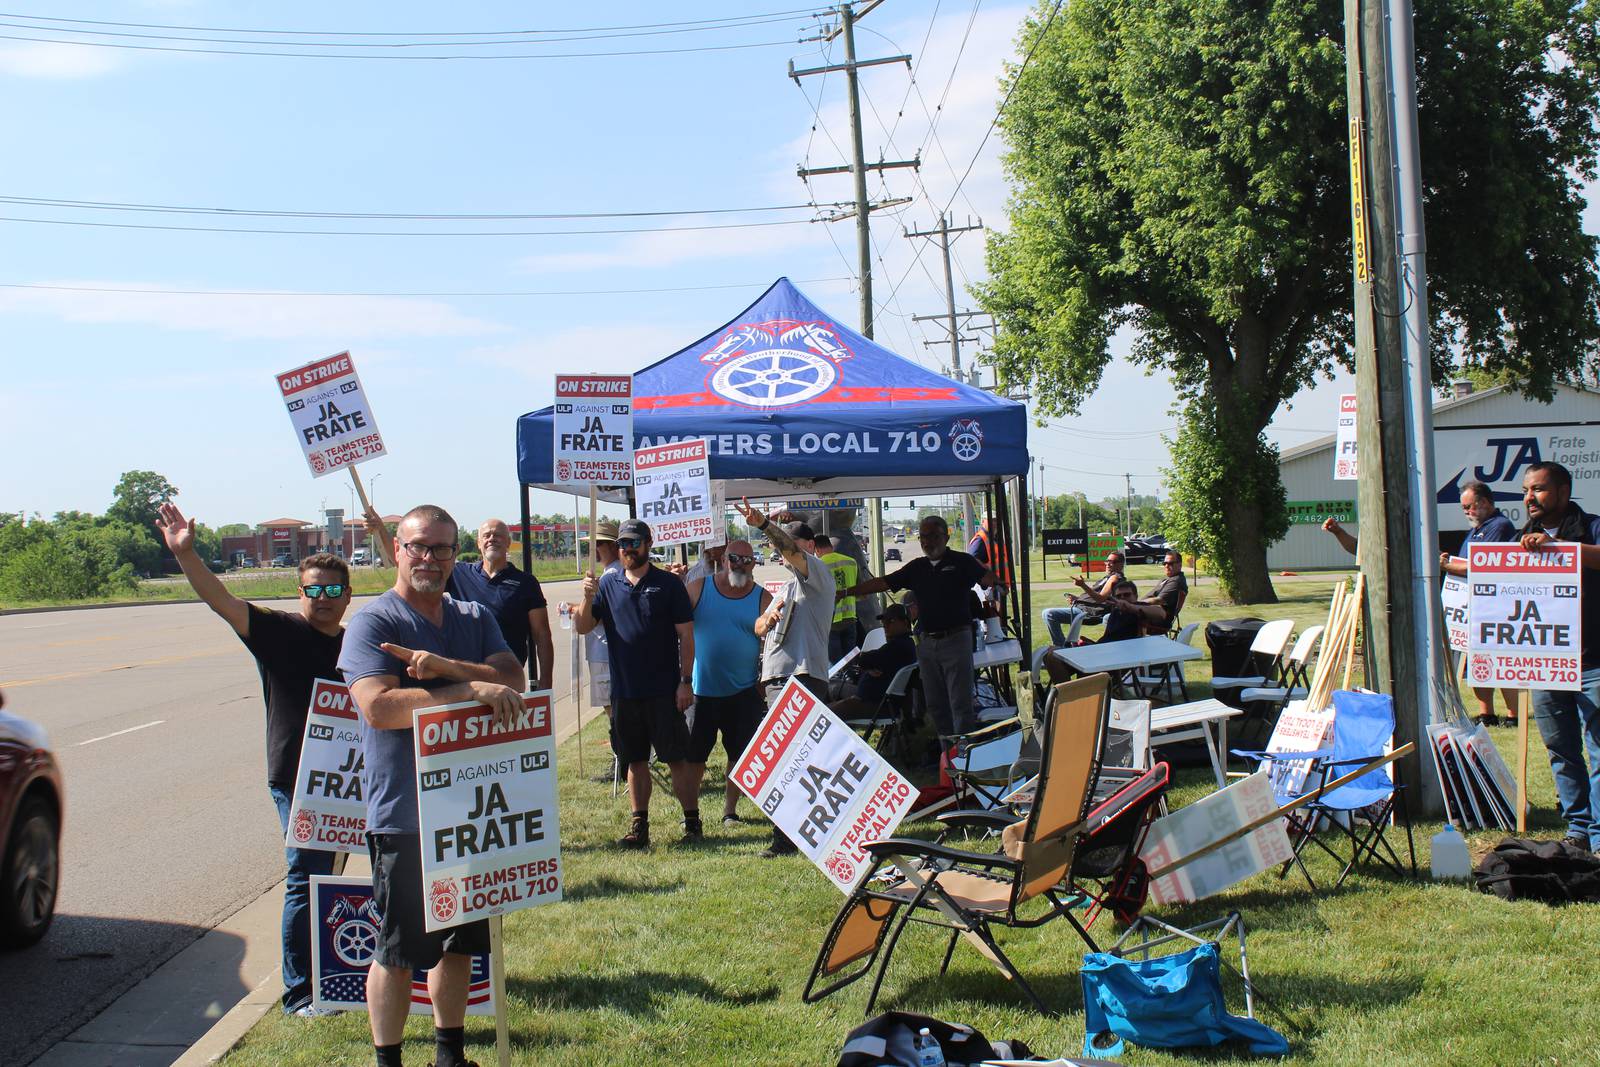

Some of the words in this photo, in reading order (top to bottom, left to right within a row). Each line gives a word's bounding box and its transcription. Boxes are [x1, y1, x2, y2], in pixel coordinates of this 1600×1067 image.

[282, 374, 302, 391] ON
[303, 358, 350, 384] STRIKE
[288, 400, 304, 411] ULP
[306, 387, 338, 405] AGAINST
[341, 382, 357, 393] ULP
[558, 381, 579, 393] ON
[581, 381, 629, 393] STRIKE
[318, 401, 342, 422] JA
[557, 405, 572, 413] ULP
[575, 405, 610, 413] AGAINST
[613, 406, 628, 414] ULP
[302, 410, 367, 446] FRATE
[580, 416, 604, 434] JA
[325, 433, 380, 457] TEAMSTERS
[561, 433, 624, 452] FRATE
[783, 431, 879, 455] LOCAL
[888, 431, 942, 454] 710
[1549, 436, 1586, 448] Frate
[328, 450, 362, 467] LOCAL
[363, 442, 383, 456] 710
[637, 454, 656, 465] ON
[658, 445, 703, 462] STRIKE
[1474, 437, 1542, 483] JA
[1552, 451, 1600, 466] Logisti
[574, 461, 631, 471] TEAMSTERS
[574, 470, 608, 480] LOCAL
[611, 471, 631, 481] 710
[636, 476, 651, 484] ULP
[654, 471, 686, 481] AGAINST
[689, 468, 704, 476] ULP
[660, 482, 683, 499] JA
[642, 495, 702, 518] FRATE
[657, 518, 711, 532] TEAMSTERS
[657, 530, 691, 542] LOCAL
[693, 526, 712, 537] 710
[1473, 551, 1502, 567] ON
[1505, 552, 1574, 567] STRIKE
[1475, 585, 1496, 595] ULP
[1500, 586, 1550, 596] AGAINST
[1555, 586, 1576, 597] ULP
[1507, 600, 1542, 622] JA
[1449, 637, 1468, 647] LOC
[1480, 622, 1570, 647] FRATE
[1496, 656, 1578, 669] TEAMSTERS
[1496, 669, 1546, 682] LOCAL
[1549, 670, 1578, 683] 710
[317, 690, 349, 711] ON
[311, 726, 333, 739] ULP
[336, 730, 363, 743] AGAI
[422, 719, 460, 746] ON
[742, 754, 767, 789] ON
[760, 689, 807, 761] STRIKE
[423, 772, 450, 788] ULP
[456, 759, 516, 783] AGAINST
[523, 753, 548, 770] ULP
[763, 789, 781, 815] ULP
[780, 741, 813, 791] AGAINST
[810, 717, 829, 741] ULP
[306, 770, 363, 802] FRA
[798, 763, 832, 805] JA
[468, 782, 510, 820] JA
[798, 751, 870, 849] FRATE
[884, 783, 910, 815] 710
[840, 771, 899, 850] TEAMSTERS
[321, 814, 366, 830] TEAMS
[316, 828, 366, 846] LOCAL
[434, 808, 545, 863] FRATE
[461, 857, 558, 892] TEAMSTERS
[462, 885, 523, 913] LOCAL
[526, 875, 559, 899] 710
